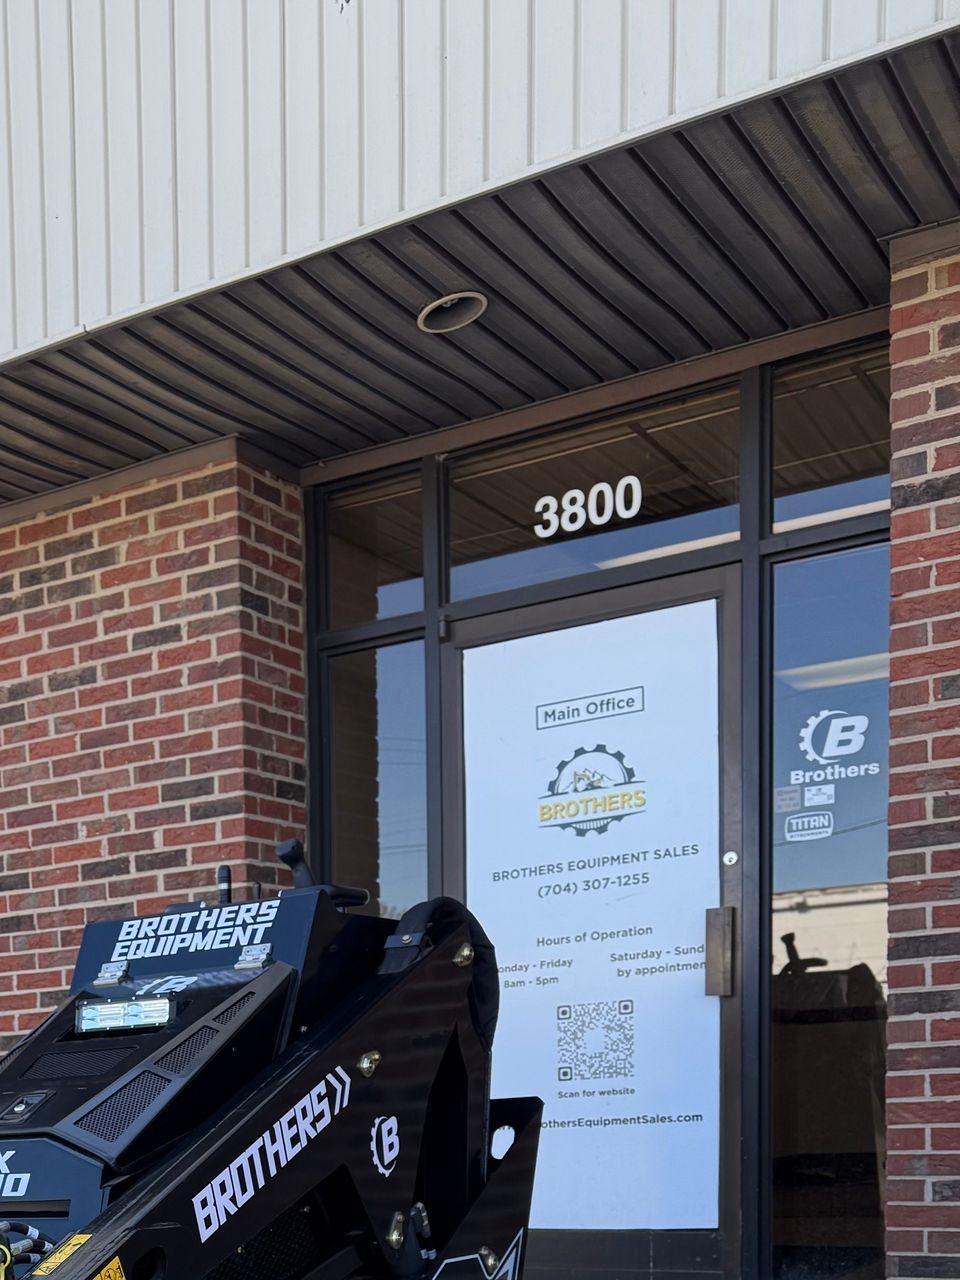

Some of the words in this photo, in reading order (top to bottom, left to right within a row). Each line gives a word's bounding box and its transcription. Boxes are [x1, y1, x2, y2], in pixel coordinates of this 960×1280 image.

[533, 475, 643, 538] 3800
[544, 706, 581, 723] Main
[586, 697, 636, 715] Office
[790, 762, 880, 785] Brothers
[539, 789, 647, 822] BROTHERS
[790, 815, 830, 831] TITAN
[492, 862, 564, 882] BROTHERS
[568, 851, 650, 871] EQUIPMENT
[653, 844, 699, 860] SALES
[538, 882, 578, 898] (704)
[583, 872, 650, 891] 307-1255
[118, 900, 281, 941] BROTHERS
[110, 922, 272, 961] EQUIPMENT
[536, 935, 571, 947] Hours
[575, 932, 587, 943] of
[590, 926, 653, 943] Operation
[609, 948, 662, 963] Saturday
[674, 944, 704, 956] Sund
[498, 961, 530, 974] onday
[540, 958, 573, 970] Friday
[617, 967, 631, 978] by
[635, 961, 707, 976] appointmen
[504, 978, 525, 989] 8am
[536, 976, 559, 987] 5pm
[558, 1089, 580, 1099] Scan
[583, 1088, 595, 1097] for
[599, 1087, 635, 1097] website
[540, 1113, 703, 1129] othersEquipmentSales.com
[192, 1079, 332, 1243] BROTHERS
